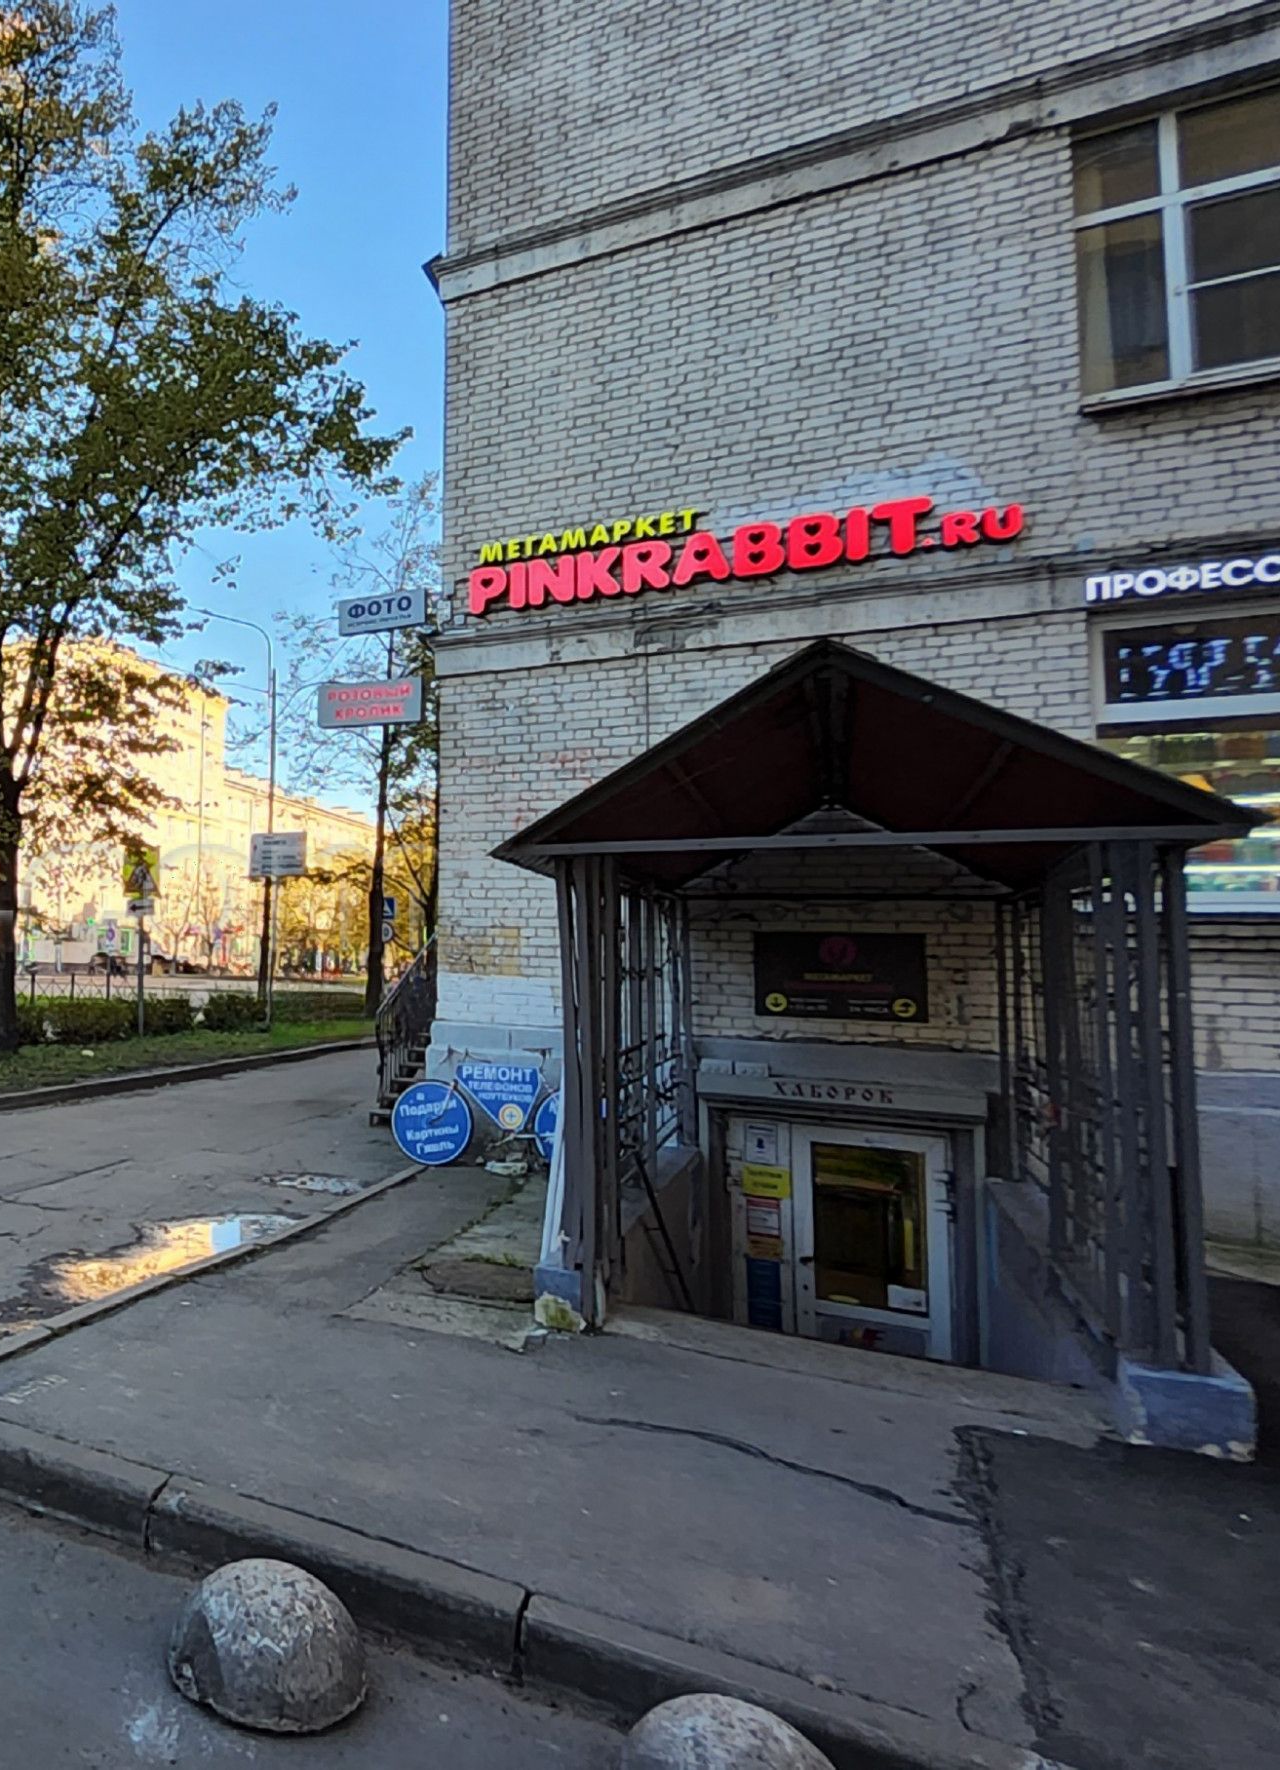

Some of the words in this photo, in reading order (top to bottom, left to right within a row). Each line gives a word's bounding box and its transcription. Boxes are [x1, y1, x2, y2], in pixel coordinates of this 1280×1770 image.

[479, 508, 700, 563] МЕГАМАРКЕТ
[347, 596, 412, 619] ФОТО
[335, 704, 402, 721] КРОЛИК
[462, 1066, 533, 1082] РЕМОНТ
[468, 1081, 533, 1093] ТЕЛЕФОНОВ
